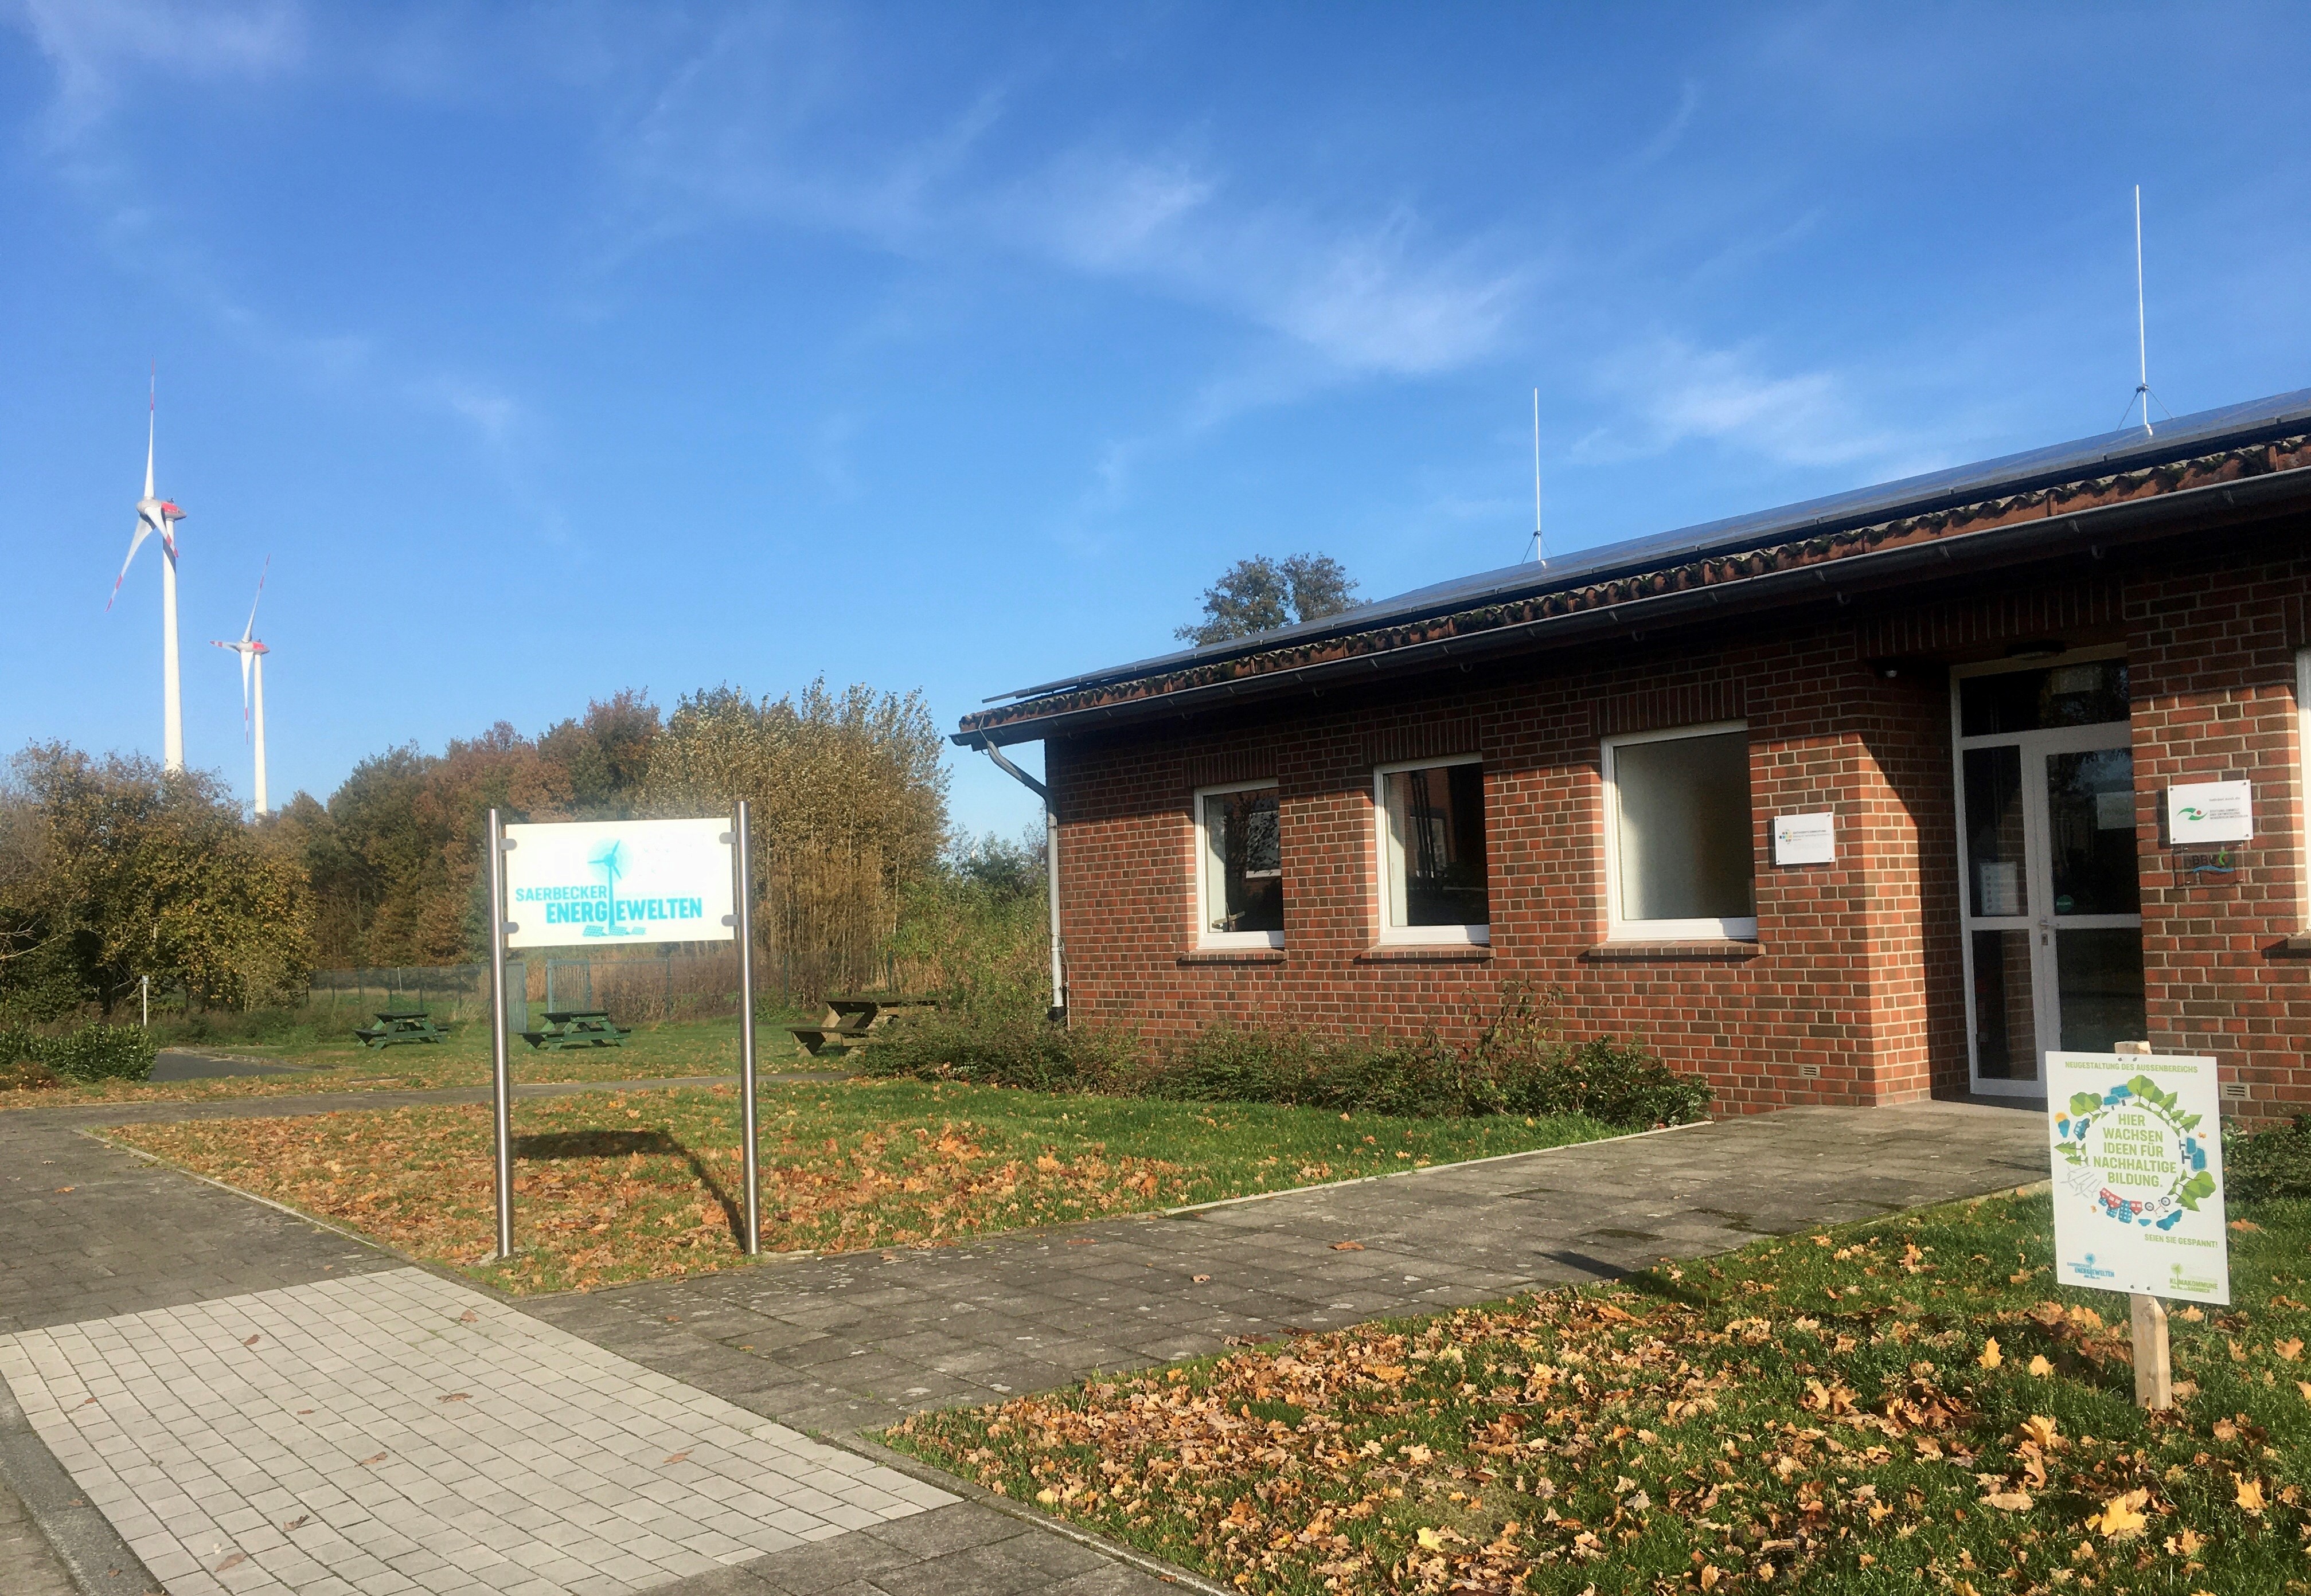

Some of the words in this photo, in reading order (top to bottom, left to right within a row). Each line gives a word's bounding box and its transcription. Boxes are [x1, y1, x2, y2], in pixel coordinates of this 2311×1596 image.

[516, 886, 607, 901] SAERBECKER
[2065, 1061, 2119, 1070] NEUGESTALTUNG
[2136, 1064, 2198, 1073] AUSSENBEREICHS
[2118, 1113, 2145, 1126] HIER
[2103, 1127, 2163, 1143] WACHSEN
[2104, 1142, 2137, 1156] IDEEN
[2141, 1143, 2164, 1157] FÜR
[2094, 1156, 2176, 1173] NACHHALTIGE
[2145, 1234, 2164, 1242] SEIEN
[2166, 1236, 2176, 1244] SIE
[2179, 1237, 2218, 1248] GESPANNT!
